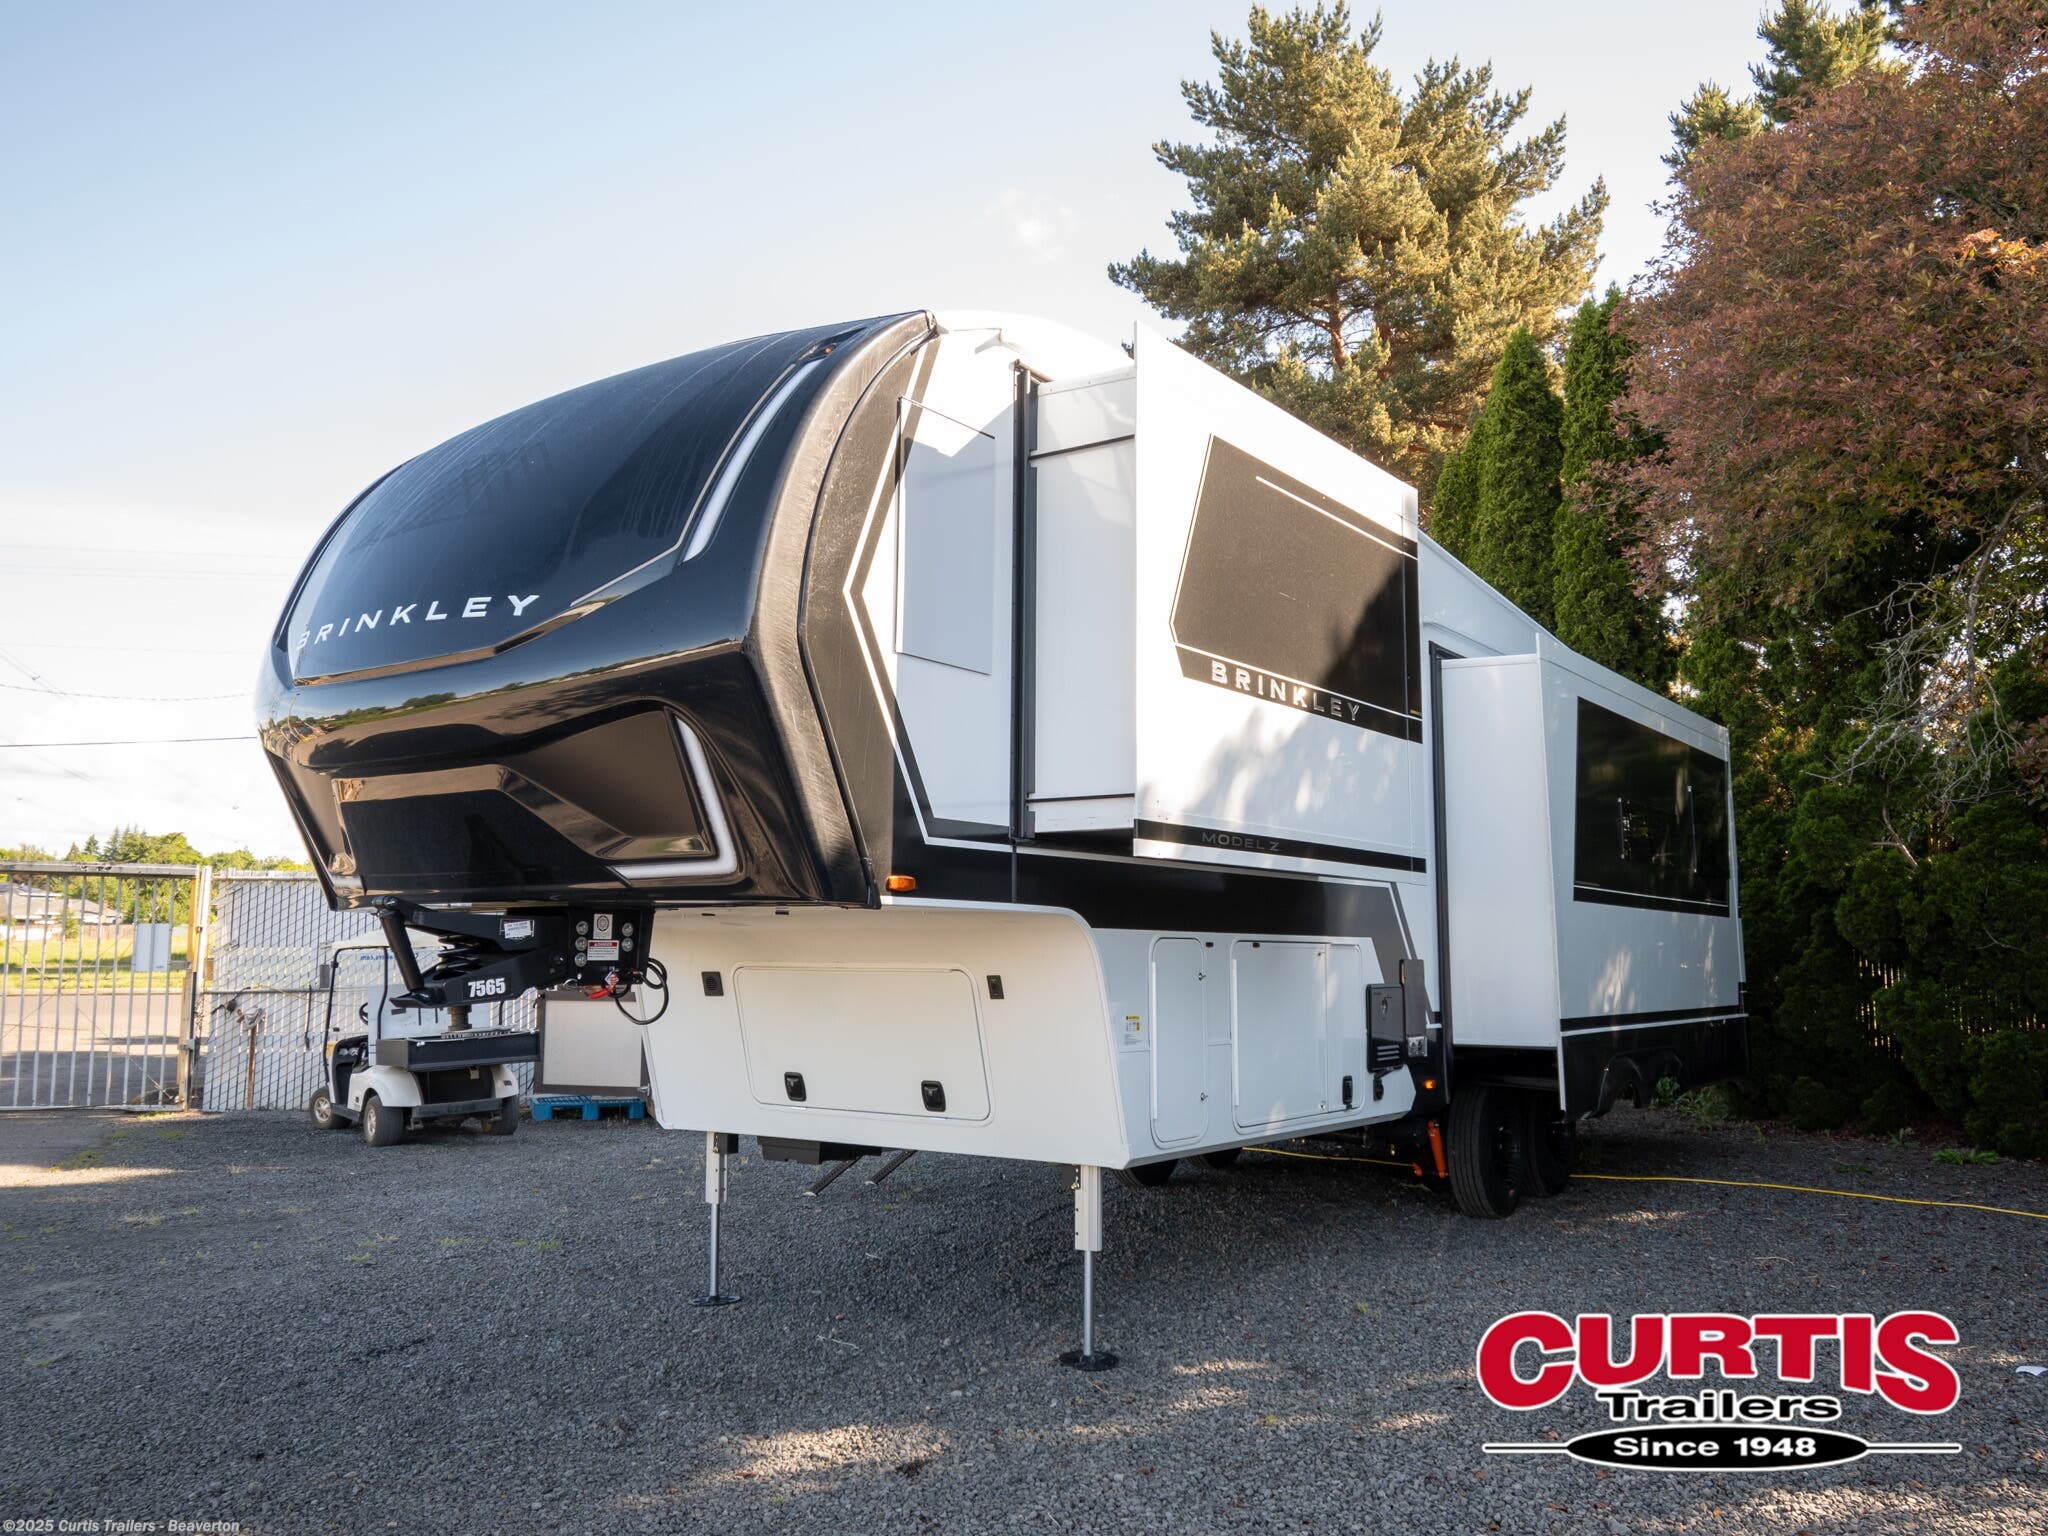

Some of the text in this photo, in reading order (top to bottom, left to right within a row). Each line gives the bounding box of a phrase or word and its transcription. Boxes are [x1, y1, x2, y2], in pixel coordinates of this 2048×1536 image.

[296, 594, 540, 651] BRINKLEY
[1211, 659, 1360, 721] BRINKLEY
[1201, 831, 1280, 851] MODEL Z
[467, 977, 506, 998] 7565
